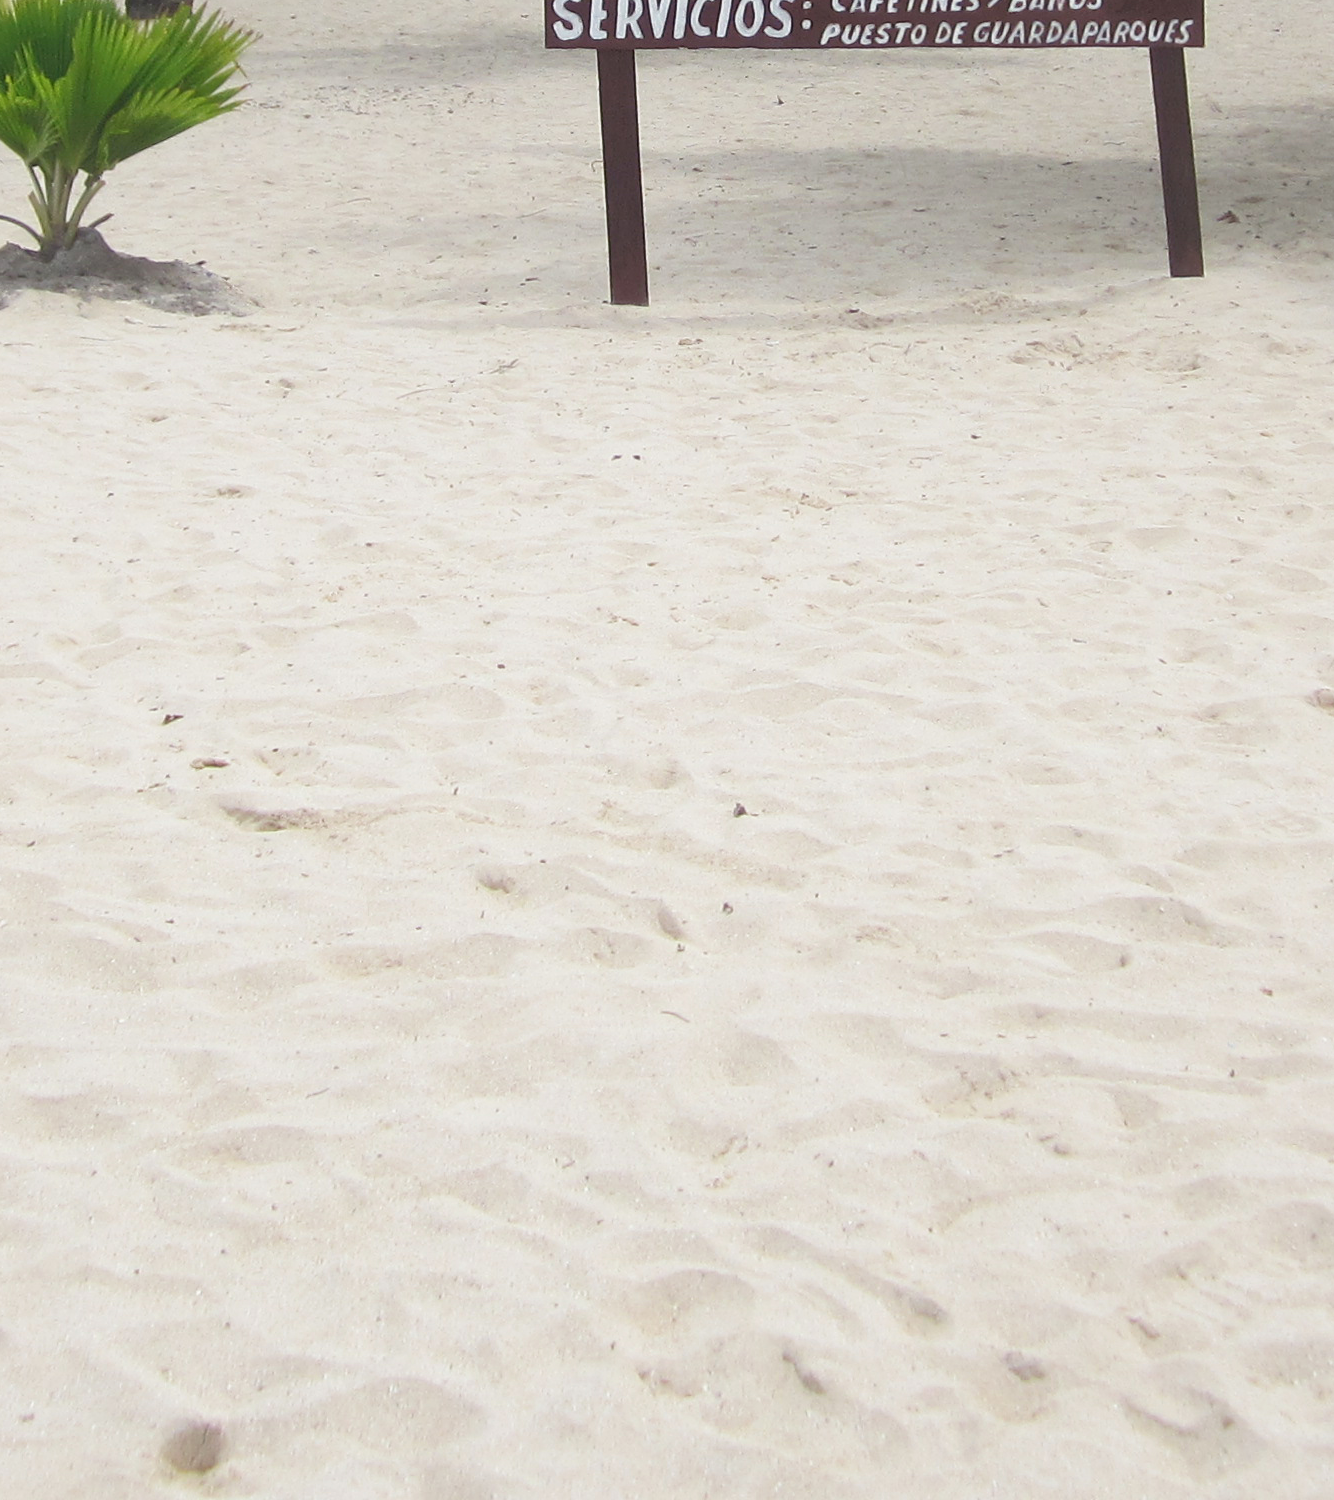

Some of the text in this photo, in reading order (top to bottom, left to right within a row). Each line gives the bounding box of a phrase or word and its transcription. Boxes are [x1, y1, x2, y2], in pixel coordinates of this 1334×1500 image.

[820, 19, 1194, 45] PUESTO DE GUARDAPARQUES
